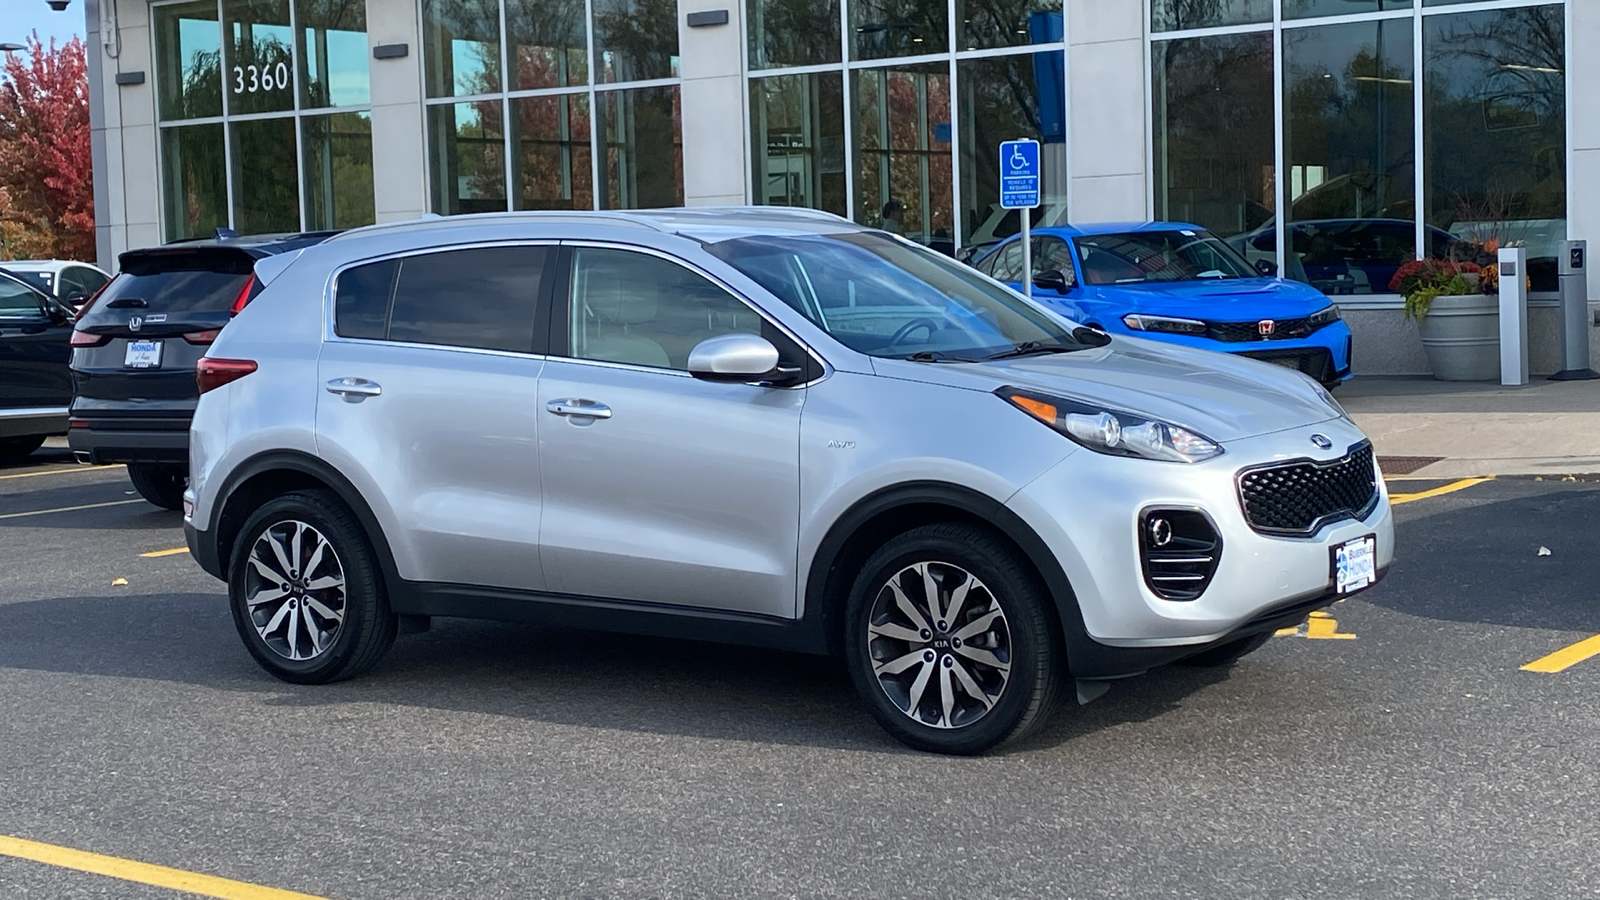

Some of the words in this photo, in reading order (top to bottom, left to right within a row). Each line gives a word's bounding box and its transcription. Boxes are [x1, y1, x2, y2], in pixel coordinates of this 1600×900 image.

[233, 62, 288, 94] 3360
[131, 344, 156, 352] HONDA
[933, 640, 950, 648] KIA
